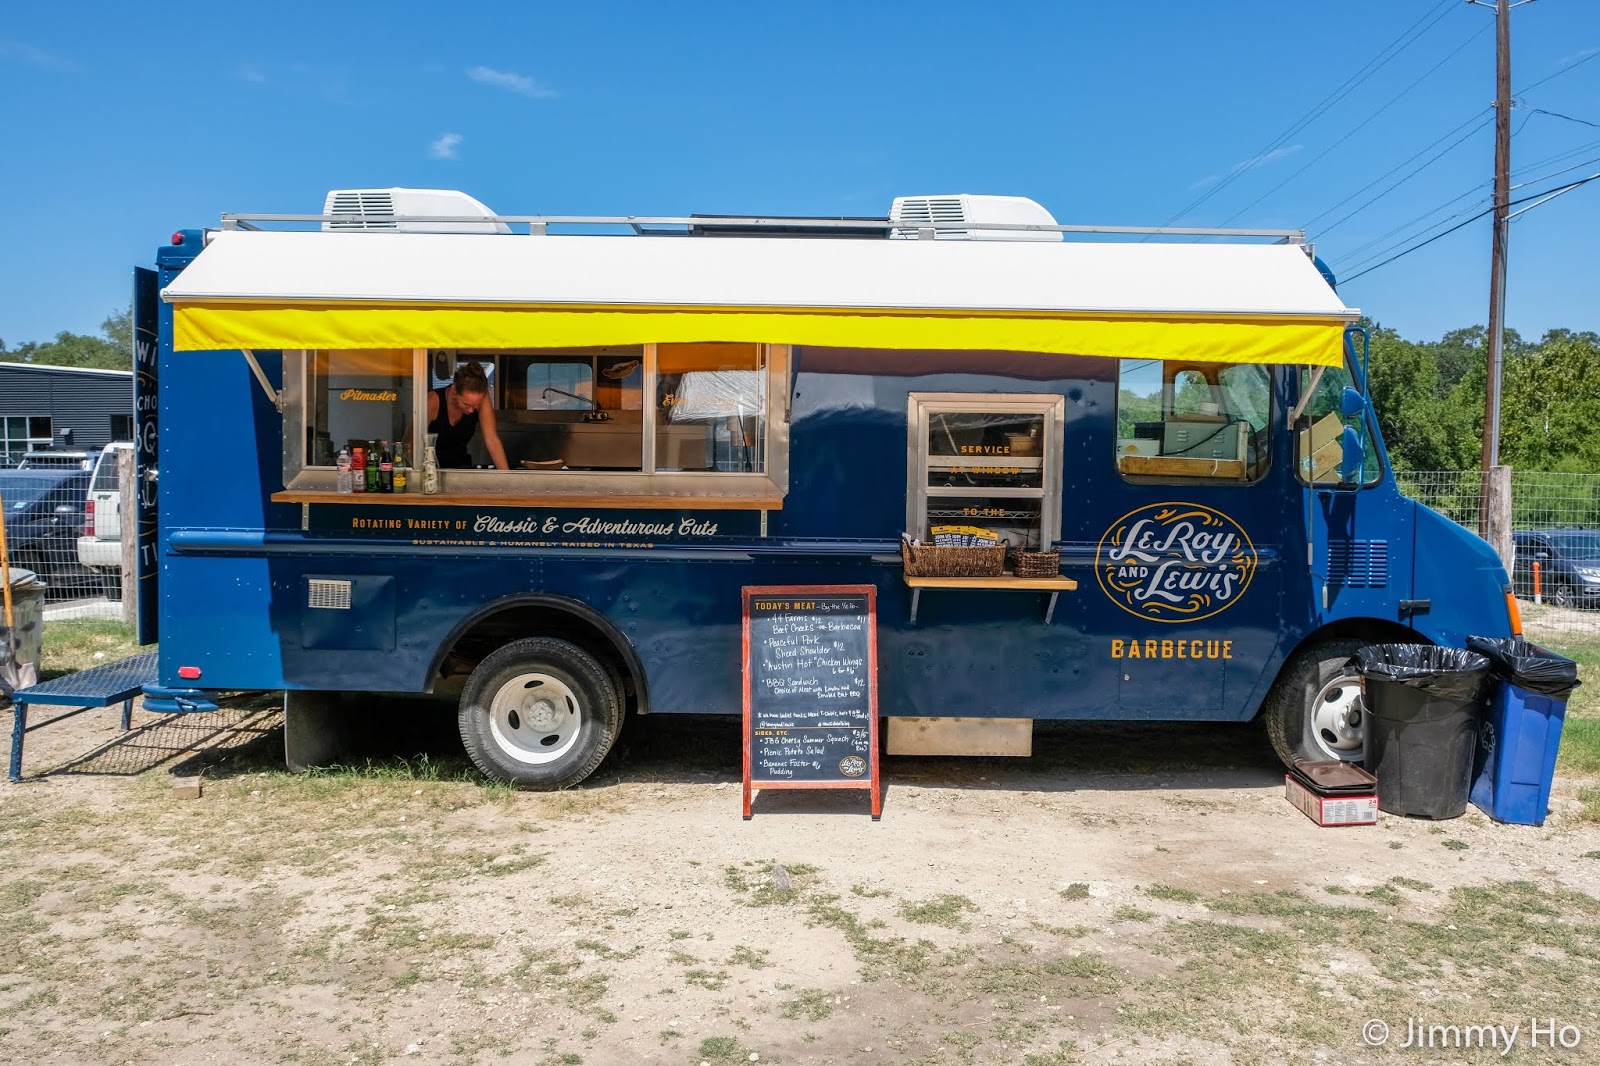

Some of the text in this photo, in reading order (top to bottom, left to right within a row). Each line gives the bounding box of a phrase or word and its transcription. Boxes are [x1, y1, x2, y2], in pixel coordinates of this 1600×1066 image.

[340, 389, 397, 401] Pitmaster
[961, 445, 1010, 454] SERVICE
[972, 467, 1019, 475] WINDOW
[963, 508, 1005, 517] TO THE
[473, 514, 538, 533] Classic
[541, 516, 559, 534] &
[562, 517, 674, 535] Adventurous
[678, 517, 718, 536] Cuts
[1118, 566, 1149, 578] AND
[1134, 560, 1239, 602] Lewis
[755, 602, 816, 610] TODAY'S MEAT
[785, 613, 808, 622] Farms
[772, 623, 789, 635] Beef
[790, 623, 814, 633] Cheeks
[827, 622, 861, 632] Barbacoa
[768, 634, 820, 648] Peaceful Pork
[775, 647, 797, 659] Sliced
[800, 646, 831, 655] Shoulder
[1111, 639, 1233, 659] BARBECUE
[817, 657, 841, 667] Chicken
[842, 657, 863, 669] Wings
[766, 678, 785, 687] BBQ
[787, 676, 819, 686] Sandwich
[802, 735, 824, 744] Summer
[826, 733, 849, 745] Squash
[763, 745, 825, 756] Picnic Potato Salad
[789, 758, 811, 767] Foster
[769, 767, 793, 778] Pudding
